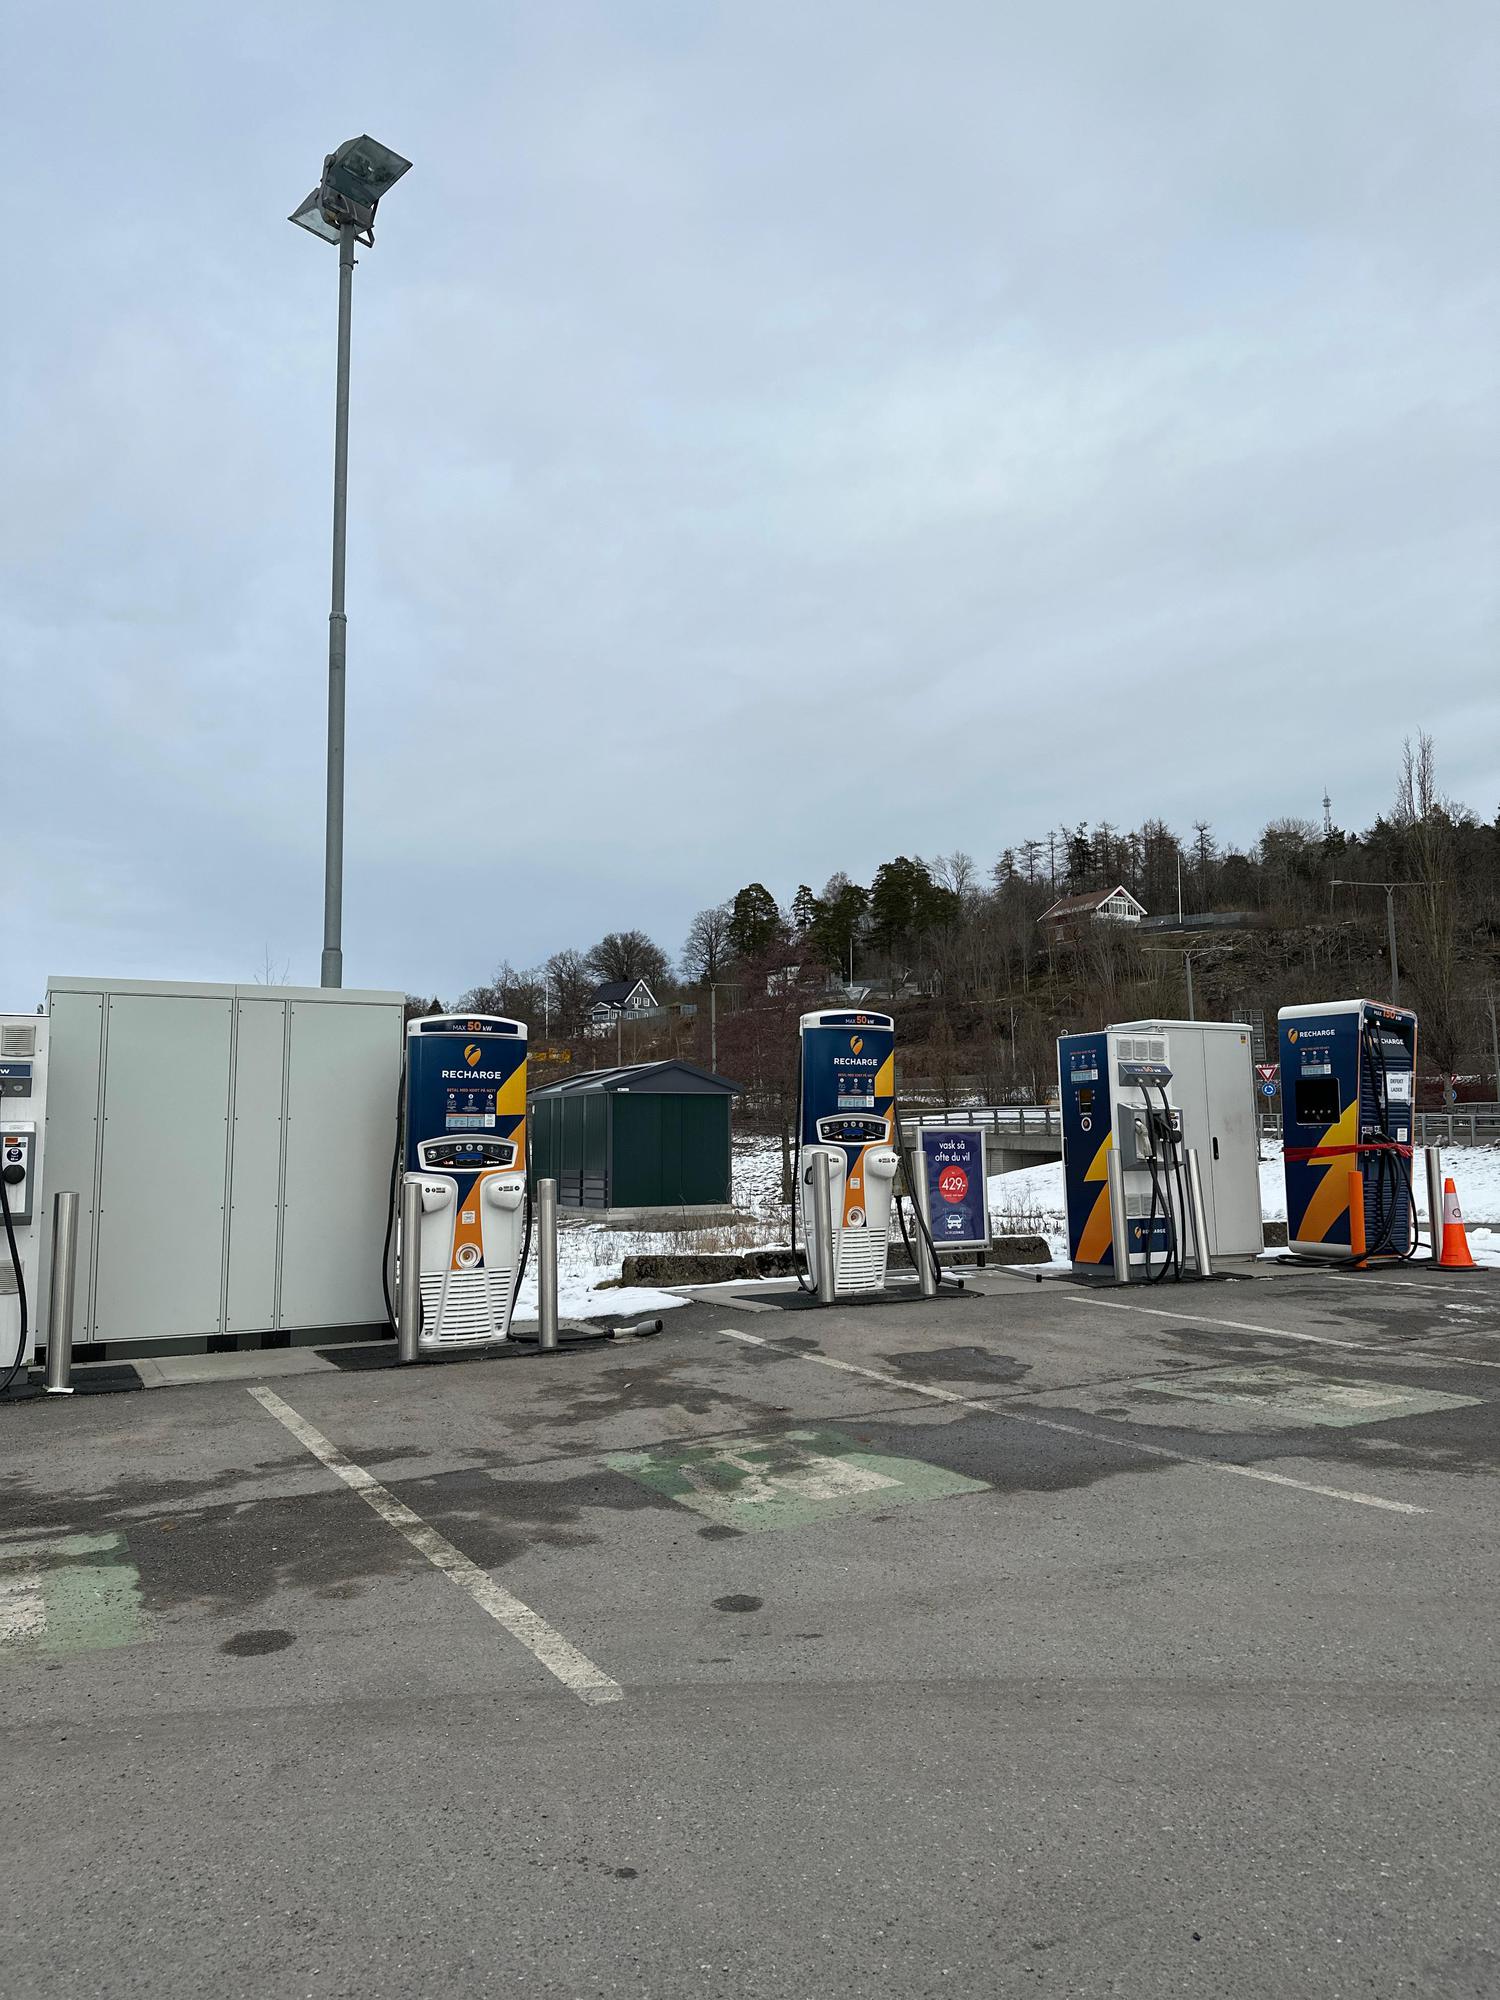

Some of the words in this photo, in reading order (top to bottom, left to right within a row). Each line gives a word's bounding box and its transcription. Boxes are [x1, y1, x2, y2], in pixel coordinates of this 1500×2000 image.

[856, 1015, 867, 1024] 50
[1383, 1009, 1396, 1020] 150
[467, 1021, 481, 1031] 50
[1299, 1029, 1336, 1039] RECHARGE
[1373, 1037, 1405, 1045] RCHARGE
[833, 1057, 878, 1066] RECHARGE
[441, 1070, 502, 1080] RECHARGE
[939, 1139, 956, 1150] vask
[957, 1140, 966, 1150] så
[934, 1151, 950, 1162] ofte
[951, 1151, 961, 1162] du
[961, 1151, 971, 1162] vil
